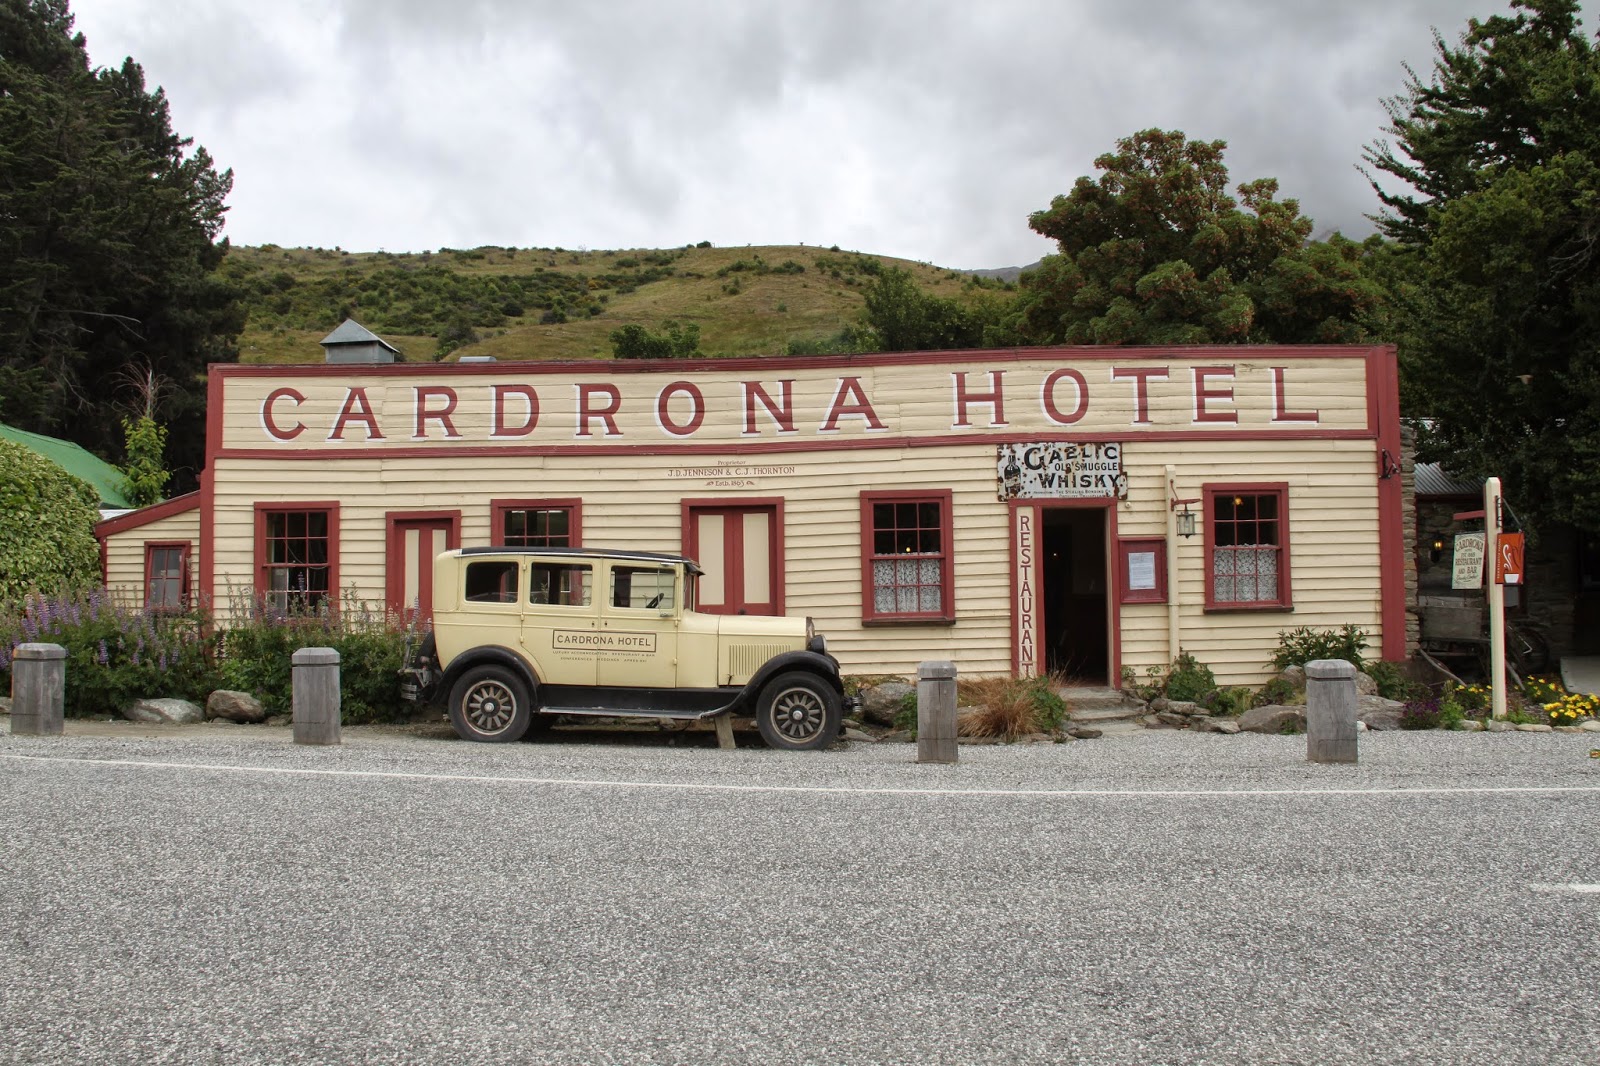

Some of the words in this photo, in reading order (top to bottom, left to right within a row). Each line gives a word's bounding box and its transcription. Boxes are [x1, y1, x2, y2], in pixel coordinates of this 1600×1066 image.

[260, 376, 889, 443] CARDRONA
[951, 365, 1320, 429] HOTEL
[1024, 446, 1118, 470] GAELIC
[725, 468, 732, 476] &
[753, 466, 795, 475] THORNTON
[1038, 473, 1120, 489] WHISKY
[1455, 557, 1482, 566] RESTAURANT
[1467, 566, 1477, 574] BAR
[1020, 515, 1033, 679] RESTAURANT
[556, 634, 614, 645] CARDRONA
[617, 637, 651, 646] HOTEL
